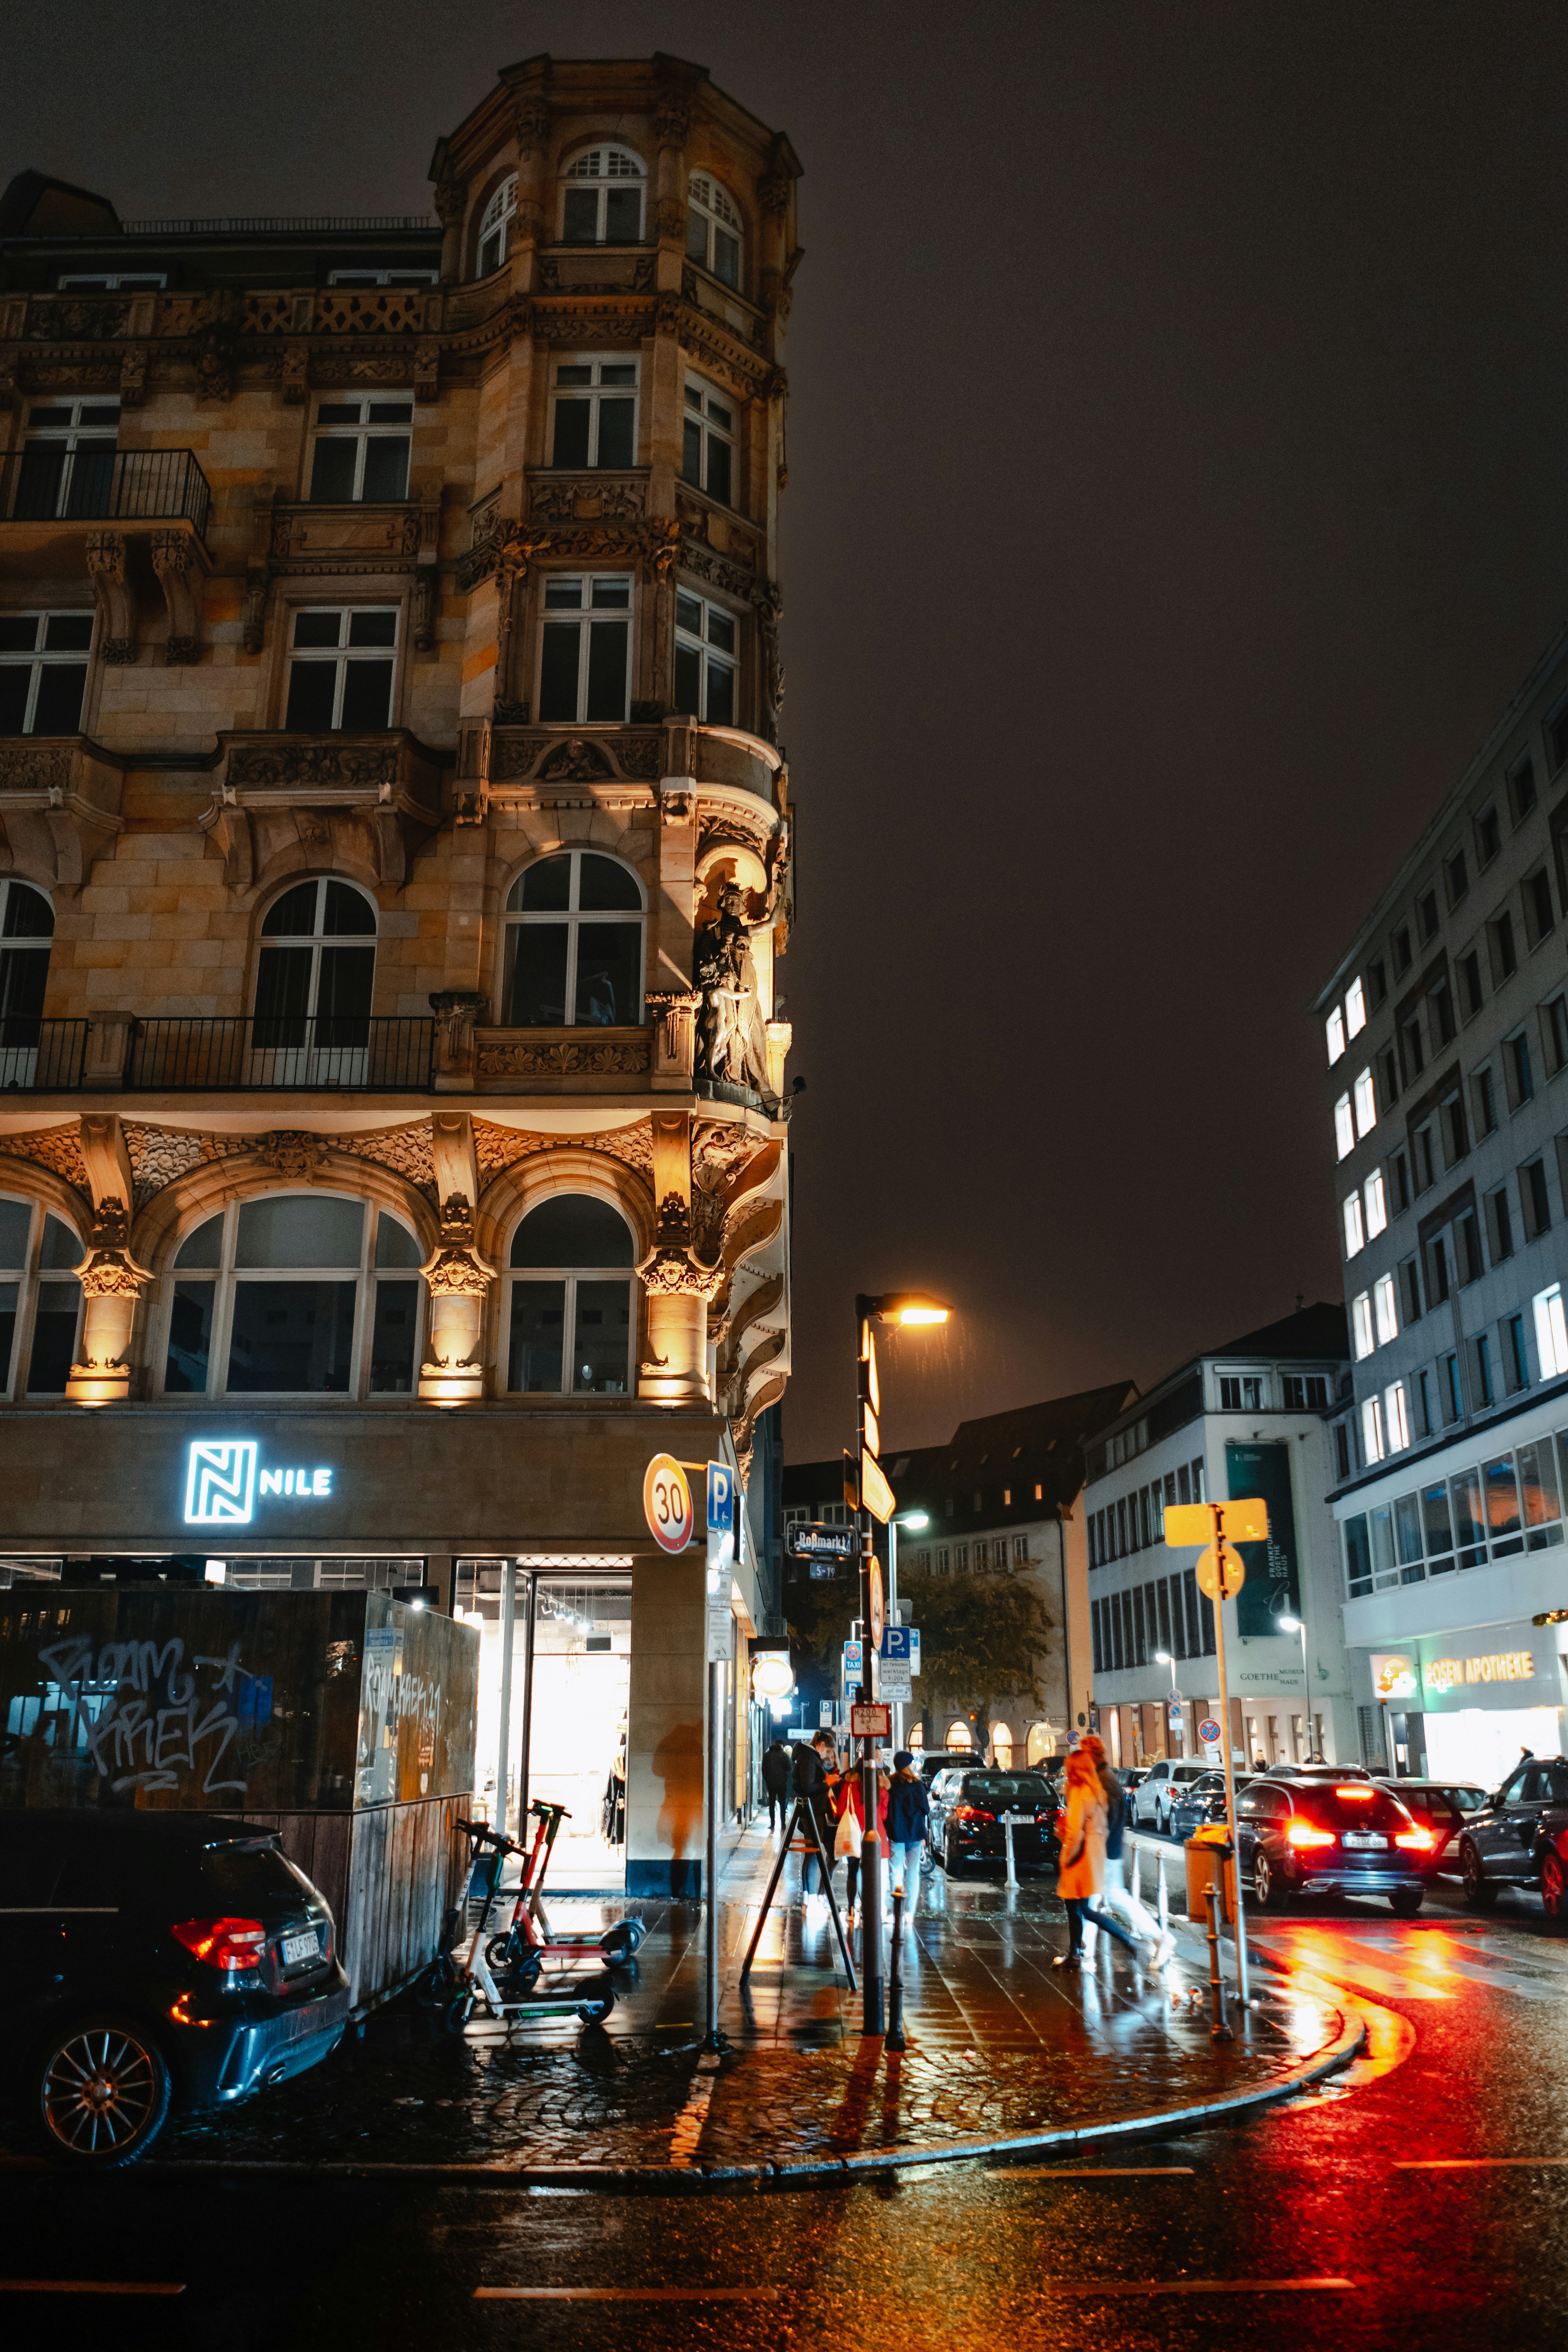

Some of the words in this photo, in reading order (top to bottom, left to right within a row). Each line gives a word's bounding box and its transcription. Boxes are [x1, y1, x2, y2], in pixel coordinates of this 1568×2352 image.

[260, 1469, 332, 1495] NILE
[656, 1482, 683, 1524] 30
[714, 1472, 728, 1521] P
[817, 1565, 835, 1577] 5-19
[888, 1631, 903, 1654] P
[1465, 1651, 1533, 1683] APOTHEKE
[823, 1702, 829, 1712] P
[459, 1875, 471, 1901] BIRD
